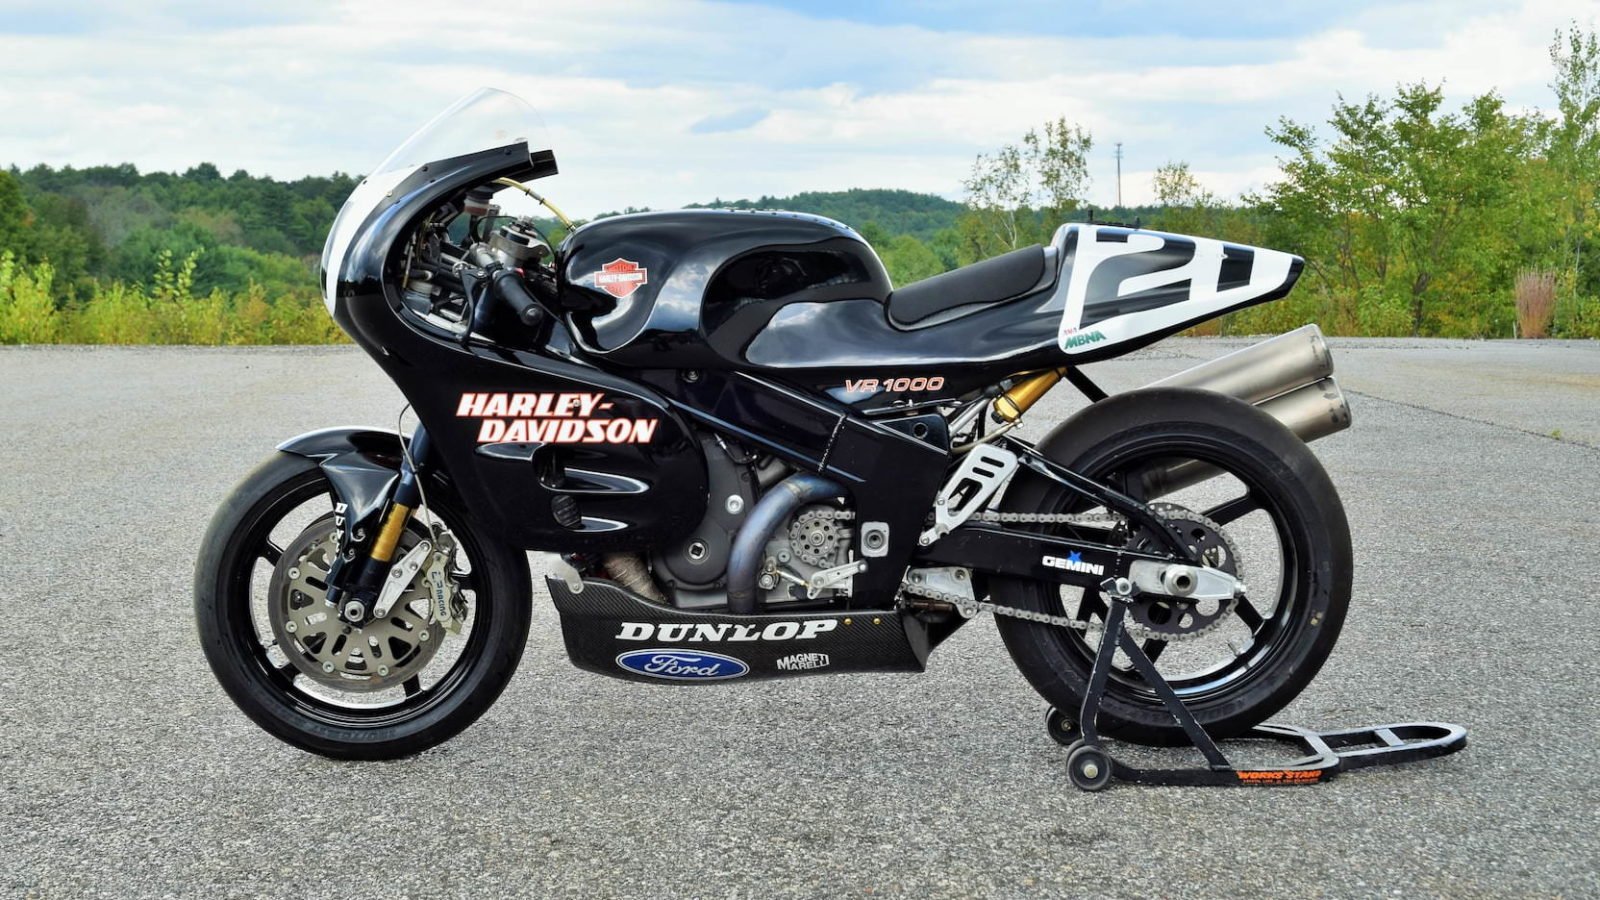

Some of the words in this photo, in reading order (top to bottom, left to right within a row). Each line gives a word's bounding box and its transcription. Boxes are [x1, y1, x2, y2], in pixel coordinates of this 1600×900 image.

[1064, 330, 1106, 349] MBNA
[845, 379, 879, 393] VR
[882, 376, 945, 392] 1000
[456, 393, 615, 416] HARLEY-
[477, 418, 659, 443] DAVIDSON
[1042, 555, 1104, 576] GEMINI
[615, 619, 838, 642] DUNLOP
[644, 654, 720, 676] Ford
[1236, 770, 1284, 779] WORKS
